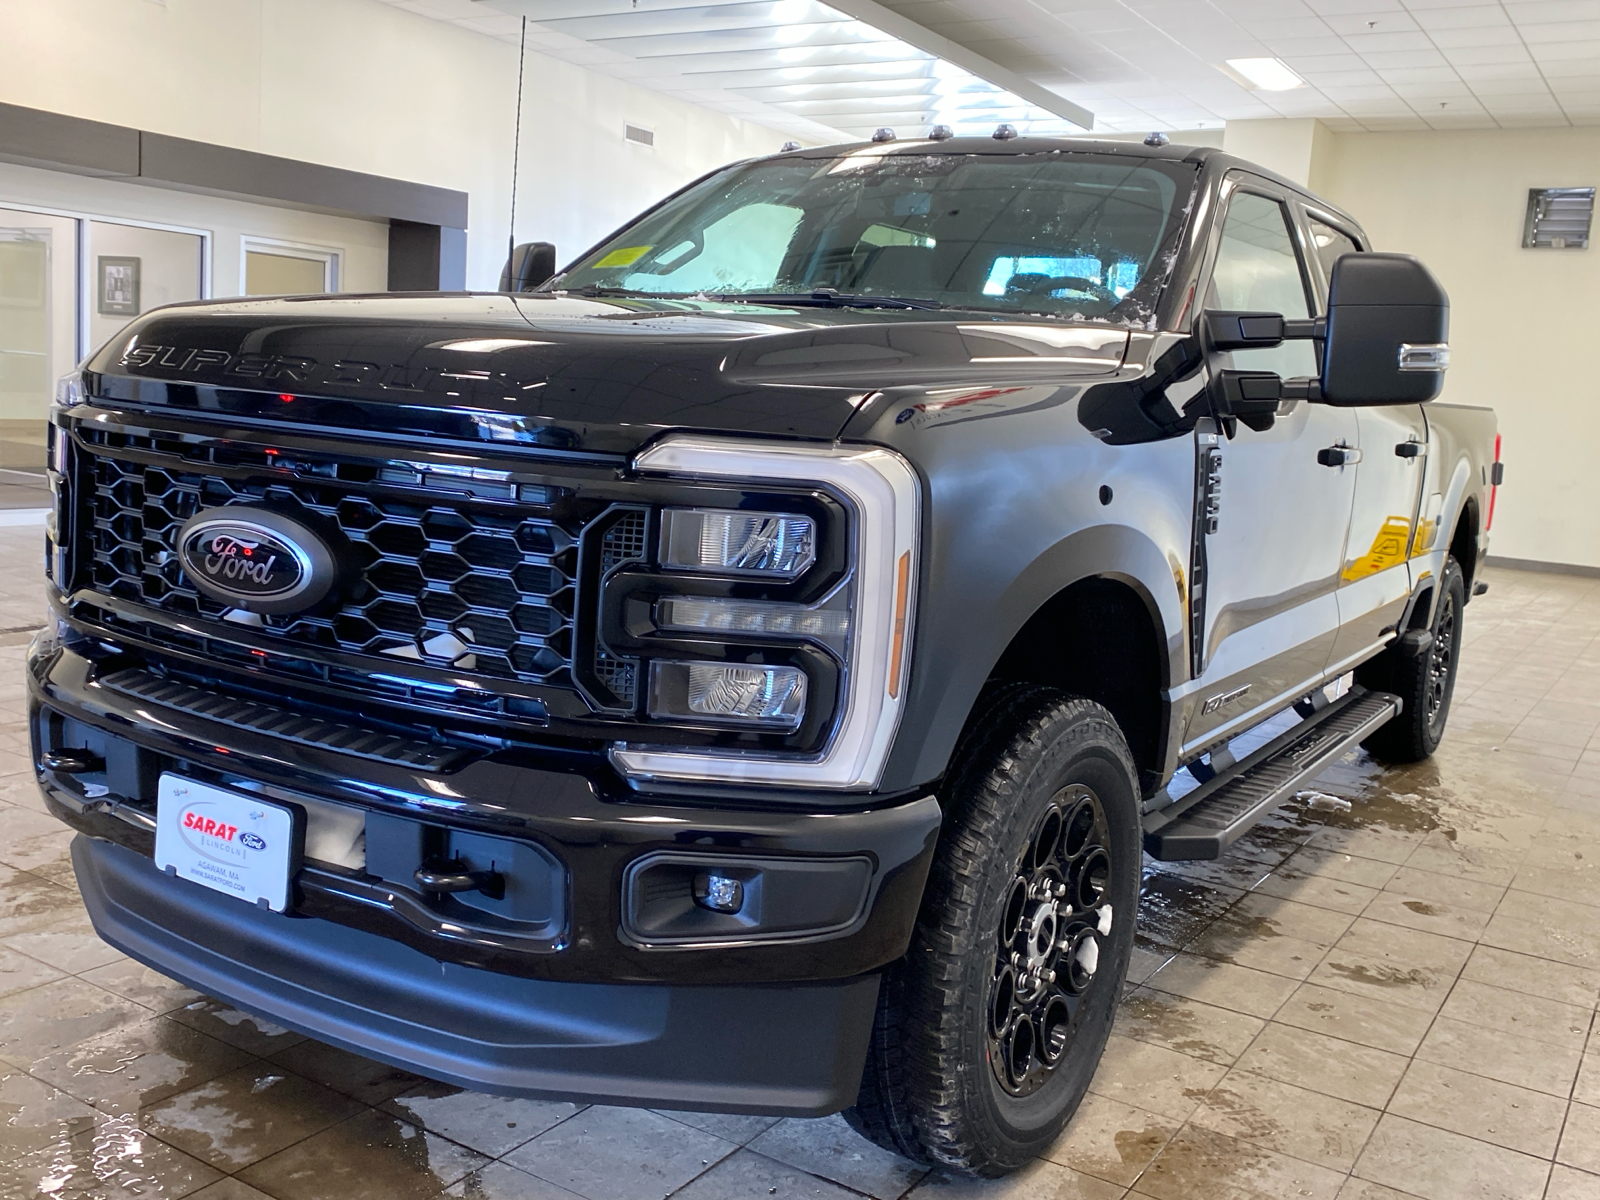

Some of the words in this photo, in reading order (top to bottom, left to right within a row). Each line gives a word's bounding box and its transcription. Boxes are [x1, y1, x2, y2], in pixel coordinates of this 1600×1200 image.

[119, 344, 317, 381] SUPER
[325, 358, 549, 402] DUTY
[204, 534, 276, 585] Ford
[183, 812, 238, 842] SARAT
[243, 833, 264, 849] Ford
[206, 839, 240, 856] LINCOLN
[190, 867, 246, 892] WWW.SARATFORD.COM
[229, 870, 239, 881] MA
